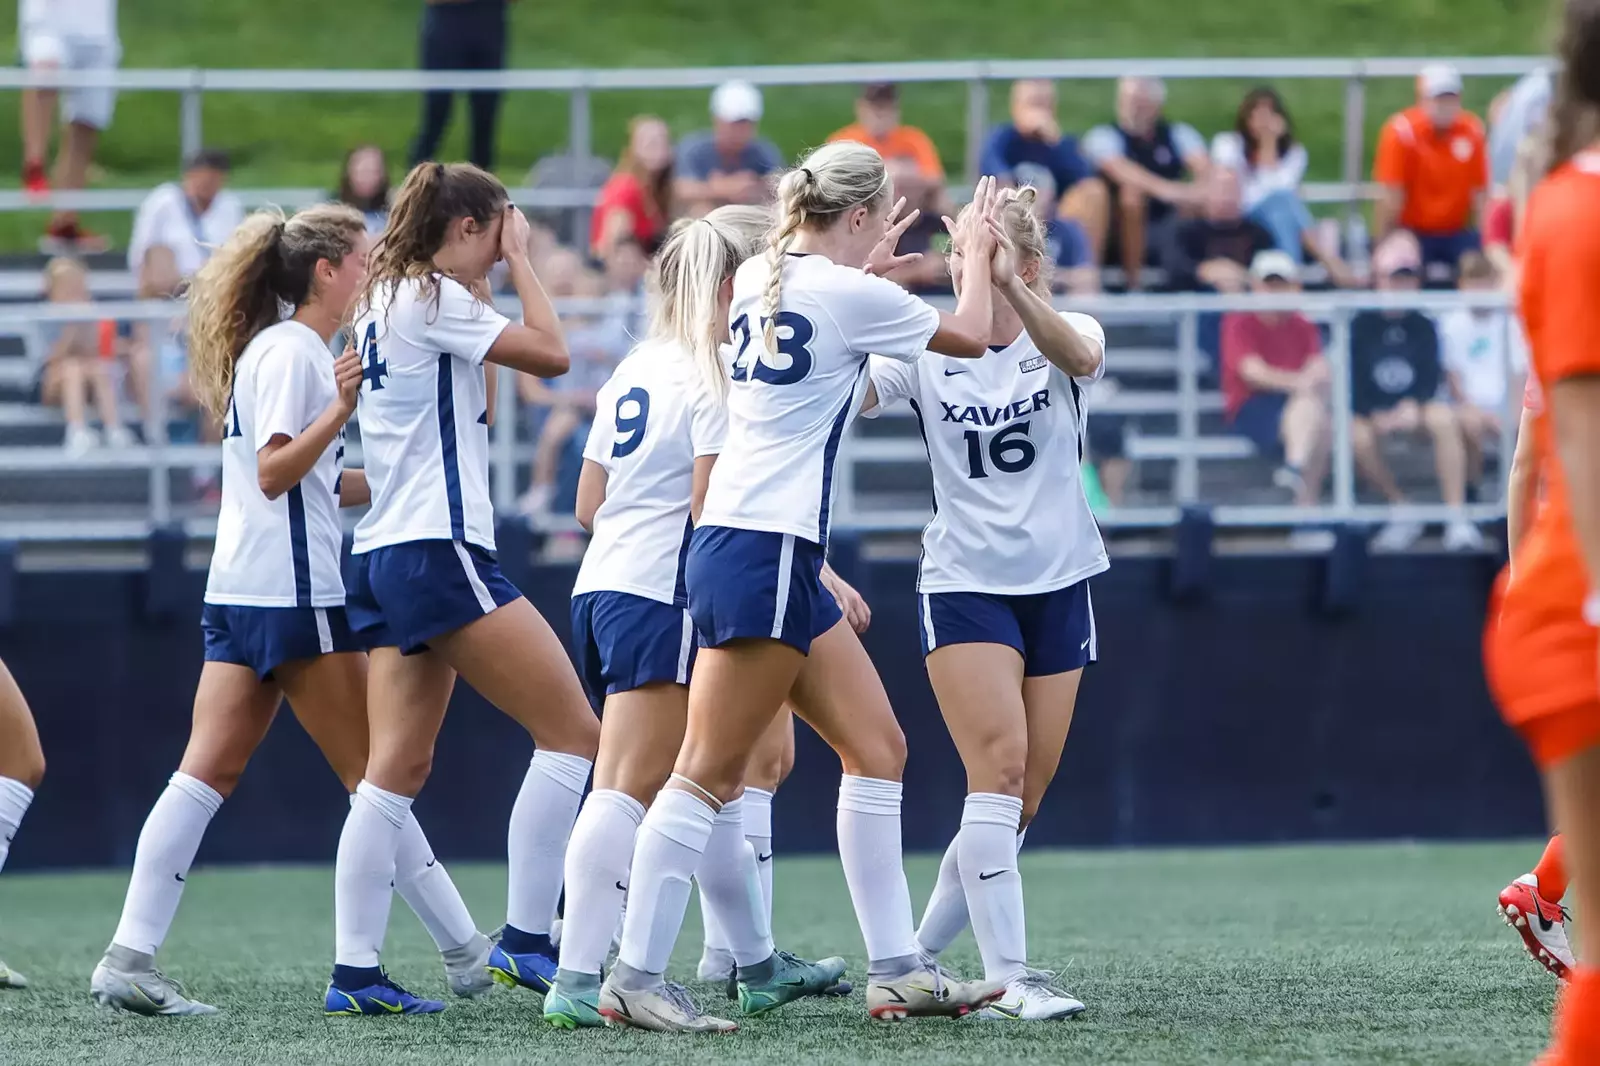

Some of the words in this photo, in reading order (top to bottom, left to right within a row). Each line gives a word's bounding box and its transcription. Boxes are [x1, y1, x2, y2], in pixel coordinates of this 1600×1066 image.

[611, 387, 650, 459] 9
[940, 389, 1051, 426] XAVIER
[963, 420, 1037, 479] 16
